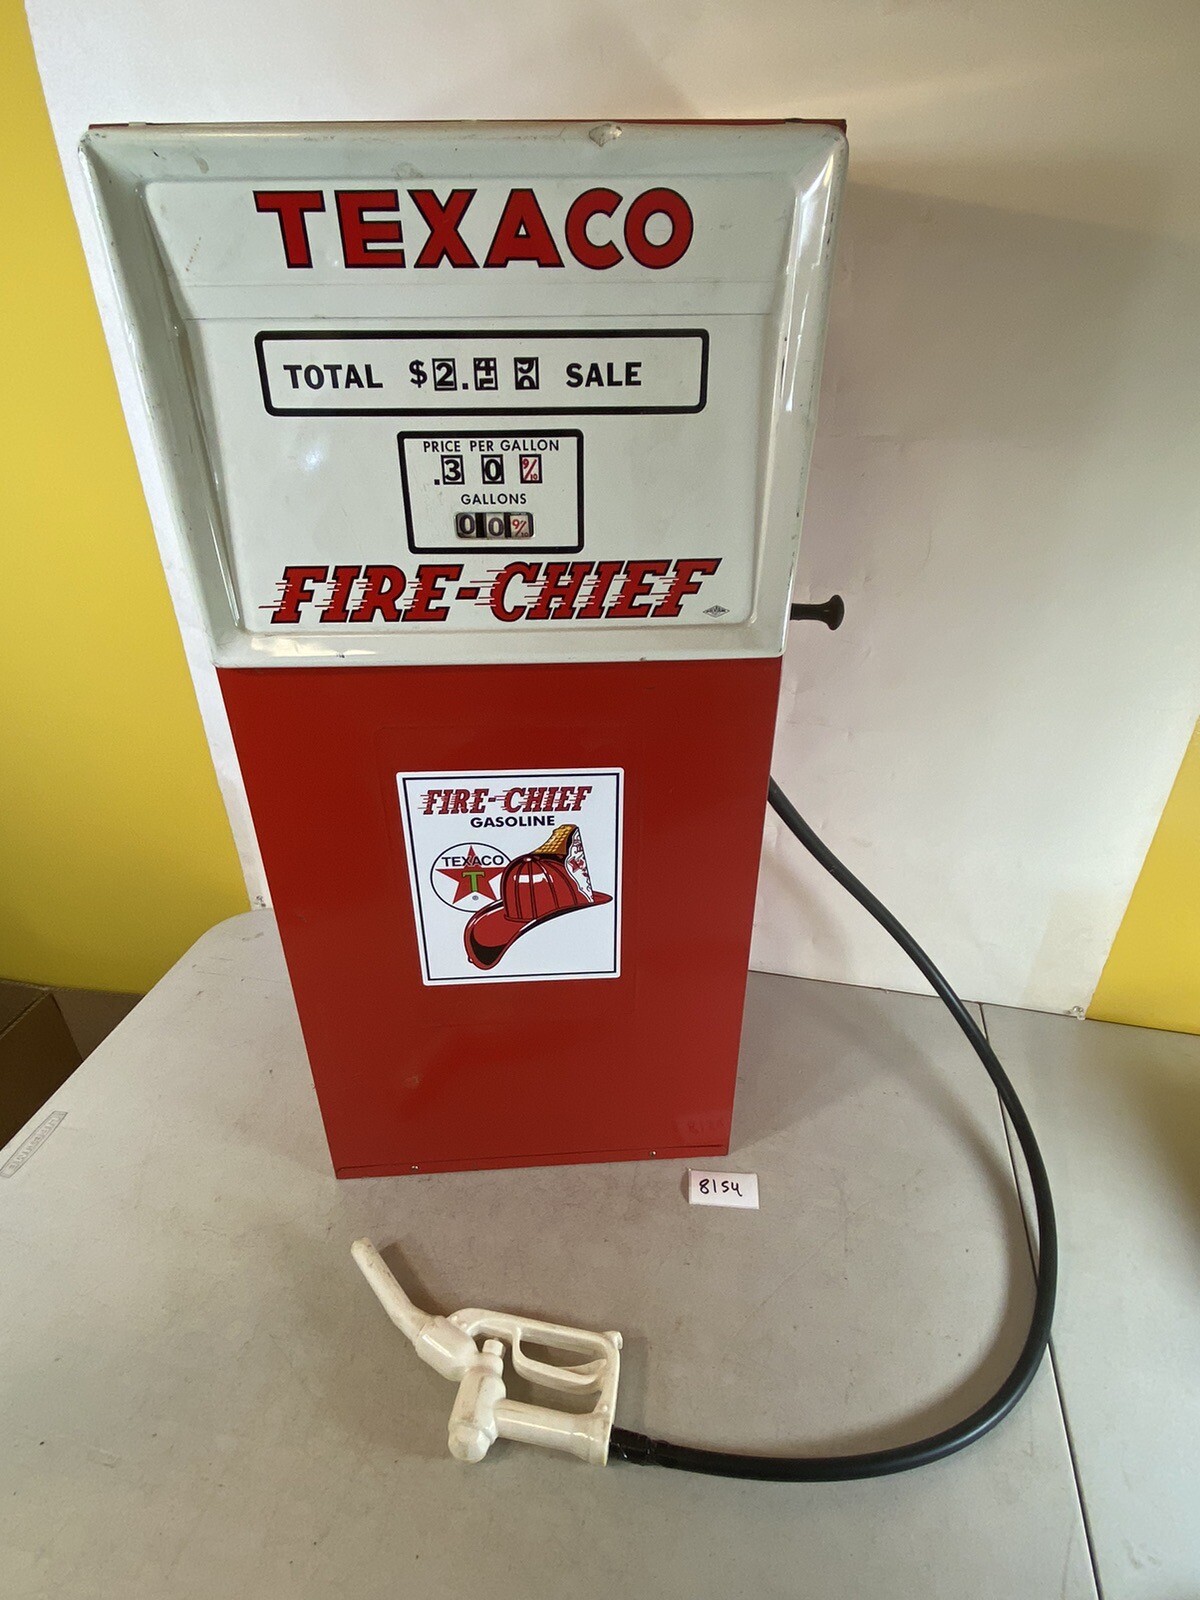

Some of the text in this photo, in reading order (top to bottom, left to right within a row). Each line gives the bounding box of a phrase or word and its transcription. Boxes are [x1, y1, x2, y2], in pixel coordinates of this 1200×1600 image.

[253, 187, 694, 270] TEXACO
[283, 364, 383, 389] TOTAL
[566, 362, 642, 388] SALE
[423, 439, 560, 453] PRICE PER GALLON
[461, 493, 527, 505] GALLONS
[268, 557, 722, 624] FIRE-CHIEF
[422, 786, 592, 815] FIRE-CHIEF
[470, 816, 555, 828] GASOLINE
[441, 855, 504, 867] TEXACO
[462, 871, 485, 892] T
[699, 1178, 743, 1197] 8154
